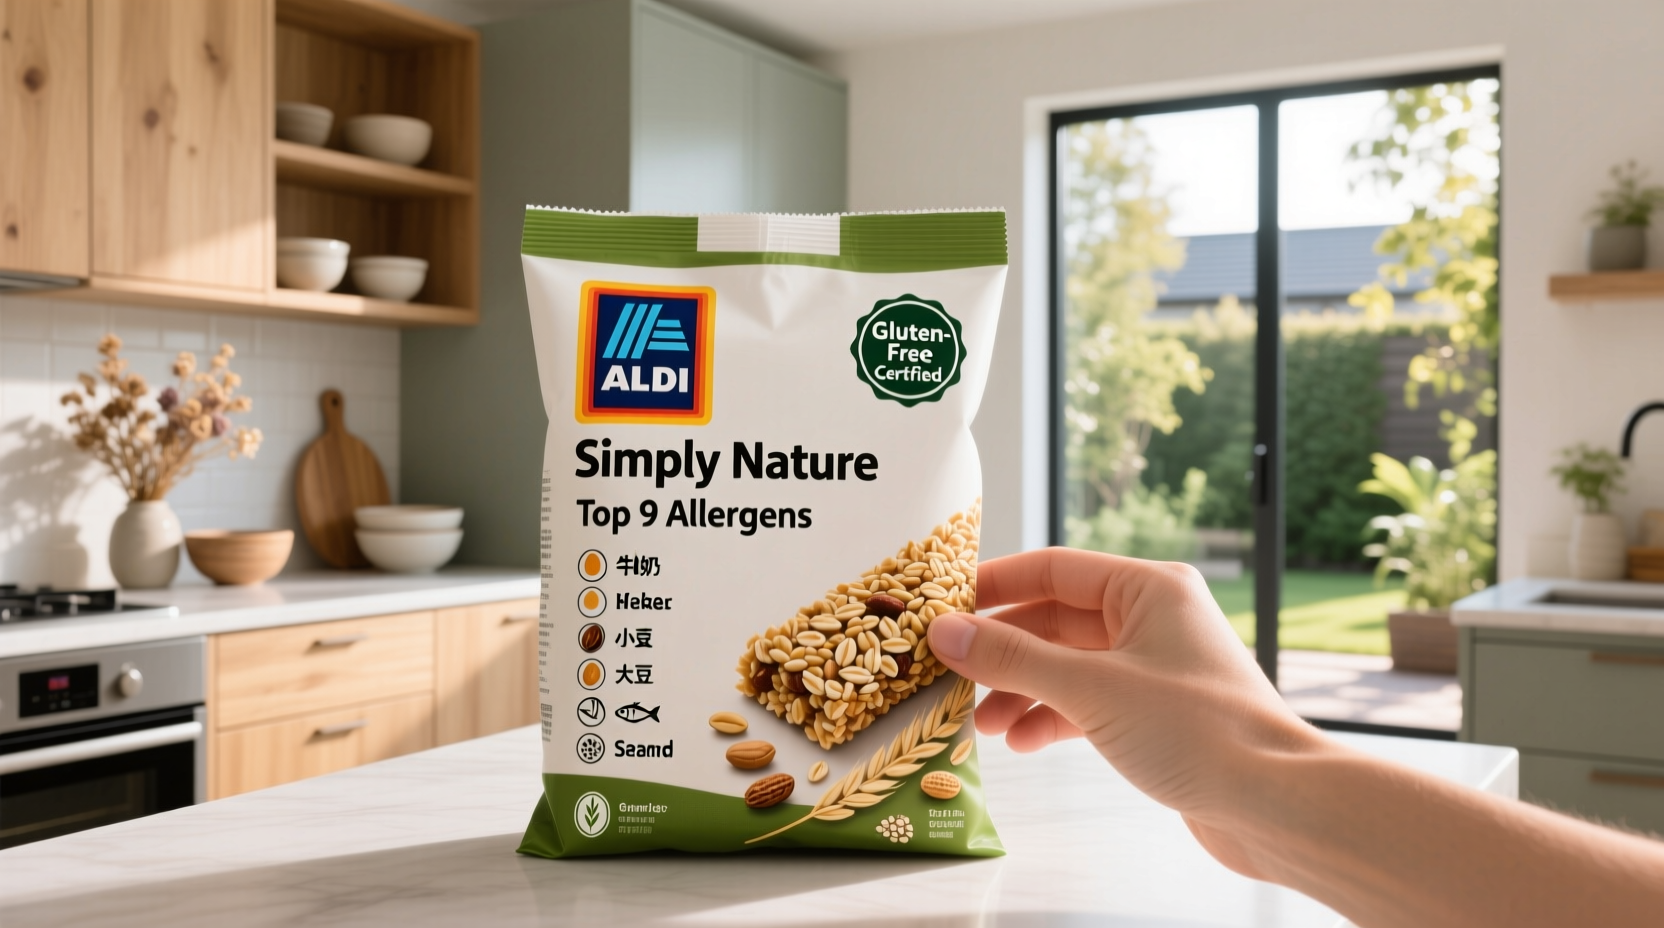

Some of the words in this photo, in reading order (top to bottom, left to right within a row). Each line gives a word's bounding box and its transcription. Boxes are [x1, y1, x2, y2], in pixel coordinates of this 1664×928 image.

[872, 321, 951, 343] Gluten-
[887, 343, 934, 364] Free
[600, 364, 689, 393] ALDI
[575, 437, 721, 489] Simply
[732, 441, 879, 481] Nature
[576, 498, 631, 535] Top
[639, 499, 659, 527] 9
[666, 498, 813, 536] Allergens
[615, 663, 654, 684] 大豆
